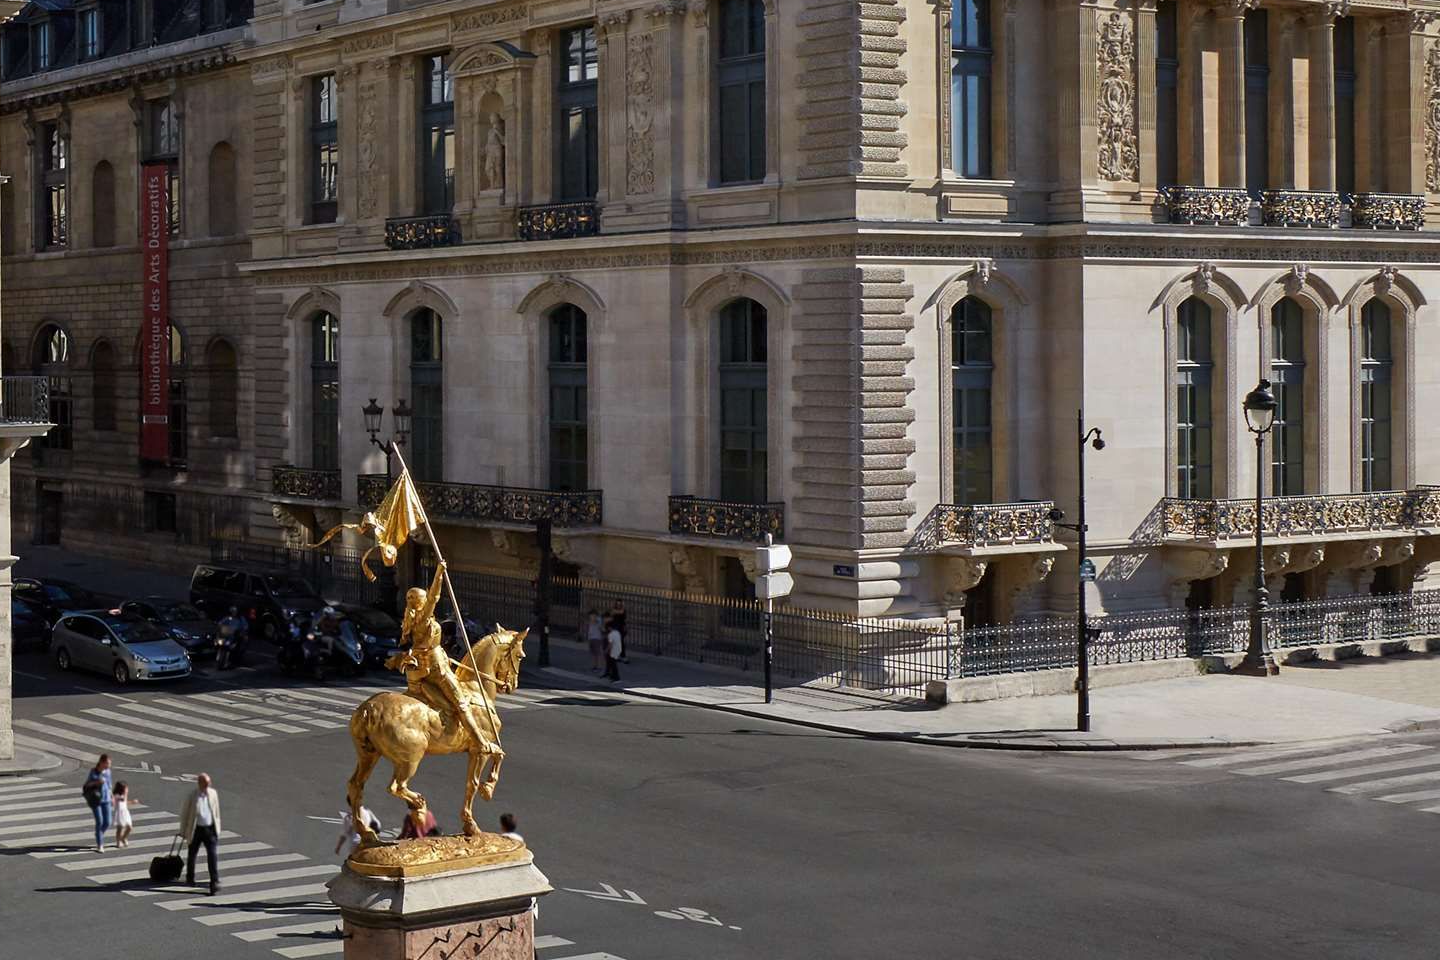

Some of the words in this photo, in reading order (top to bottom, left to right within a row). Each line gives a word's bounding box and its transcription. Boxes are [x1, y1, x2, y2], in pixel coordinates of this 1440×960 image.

[148, 176, 160, 248] Décoratifs
[149, 254, 161, 282] Arts
[149, 288, 161, 311] des
